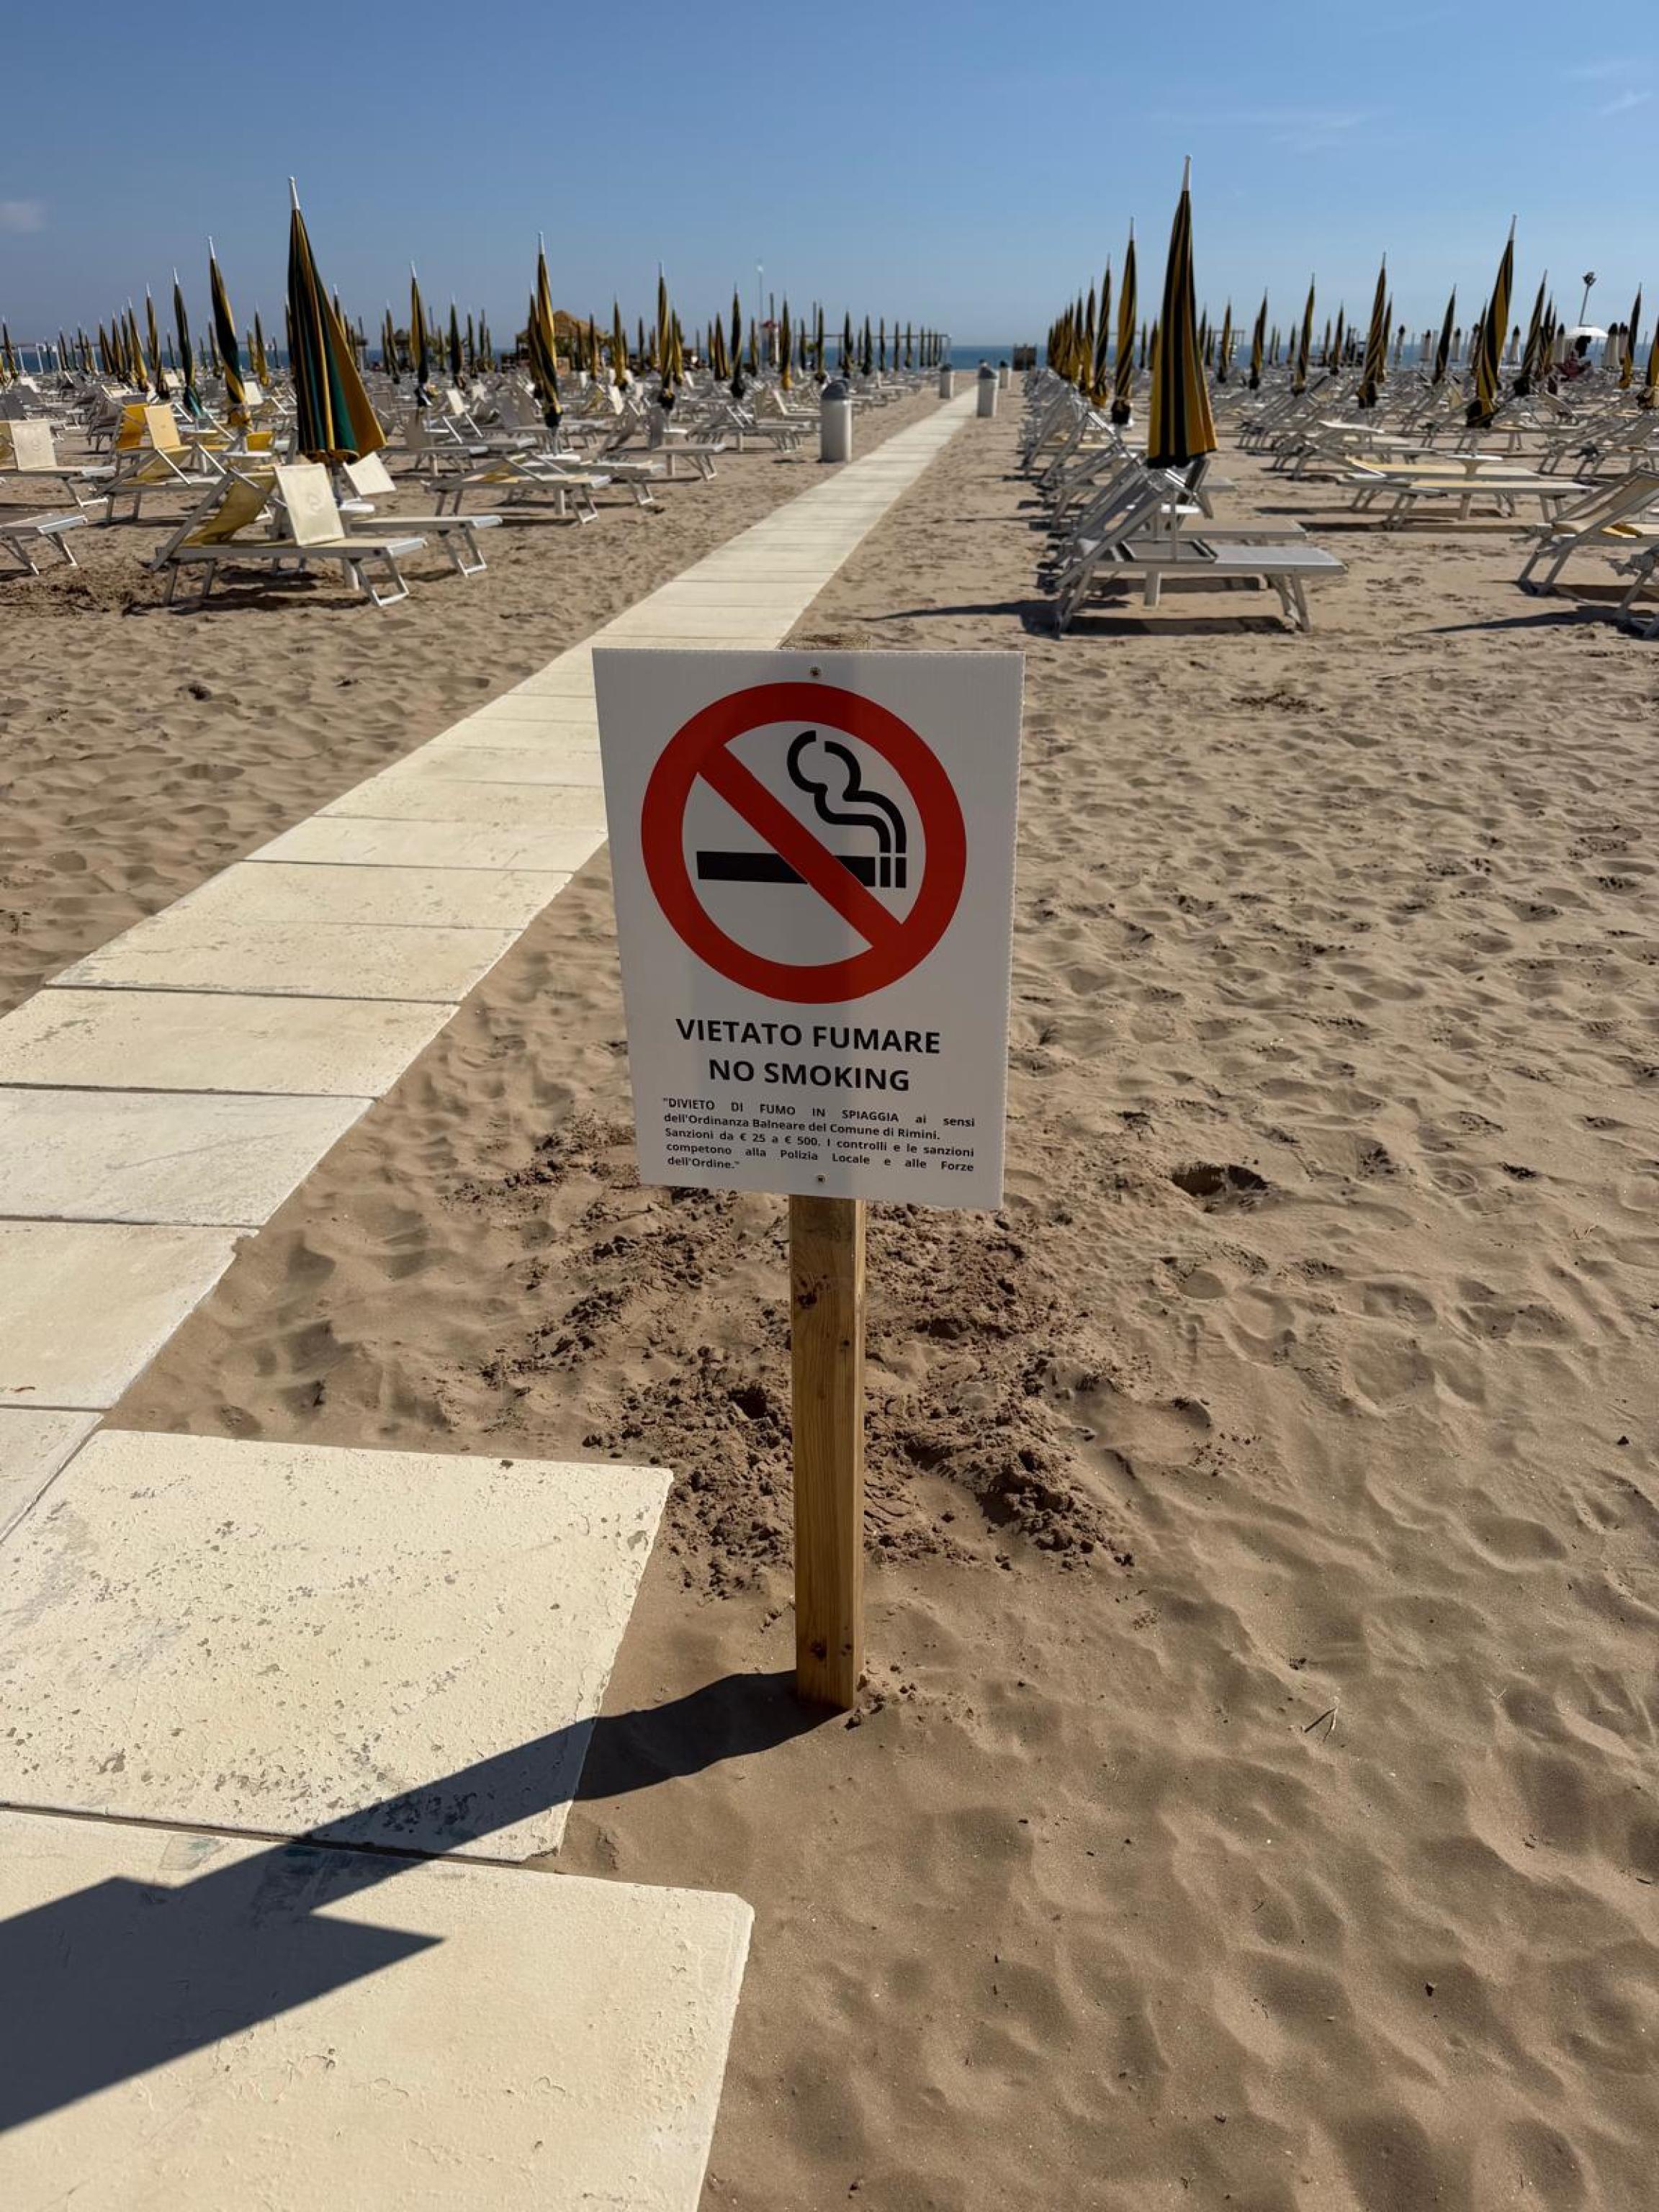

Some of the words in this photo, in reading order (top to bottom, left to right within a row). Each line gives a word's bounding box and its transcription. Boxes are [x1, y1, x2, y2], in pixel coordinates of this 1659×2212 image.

[675, 1019, 803, 1046] VIETATO
[812, 1026, 940, 1054] FUMARE
[709, 1059, 755, 1082] NO
[764, 1062, 909, 1092] SMOKING
[663, 1097, 715, 1111] "DIVIETO
[731, 1102, 743, 1112] DI
[760, 1103, 796, 1115] FUMO
[812, 1107, 826, 1118] IN
[841, 1110, 899, 1123] SPIAGGIA
[914, 1115, 927, 1124] ai
[943, 1118, 975, 1128] sensi
[664, 1113, 749, 1128] dell'Ordinanza
[752, 1118, 806, 1131] Balneare
[809, 1122, 827, 1132] del
[830, 1123, 880, 1136] Comune
[883, 1127, 894, 1137] di
[898, 1128, 940, 1140] Rimini.
[665, 1128, 714, 1139] Sanzioni
[719, 1130, 734, 1141] da
[739, 1133, 747, 1141] €
[752, 1133, 766, 1143] 25
[784, 1136, 792, 1144] €
[797, 1136, 821, 1146] 500.
[827, 1138, 830, 1147] I
[836, 1140, 887, 1151] controlli
[906, 1143, 917, 1154] le
[923, 1146, 974, 1158] sanzioni
[666, 1143, 732, 1155] competono
[745, 1147, 767, 1158] alla
[780, 1149, 818, 1161] Polizia
[832, 1153, 871, 1164] Locale
[884, 1158, 891, 1166] e
[904, 1158, 927, 1169] alle
[940, 1161, 974, 1172] Forze
